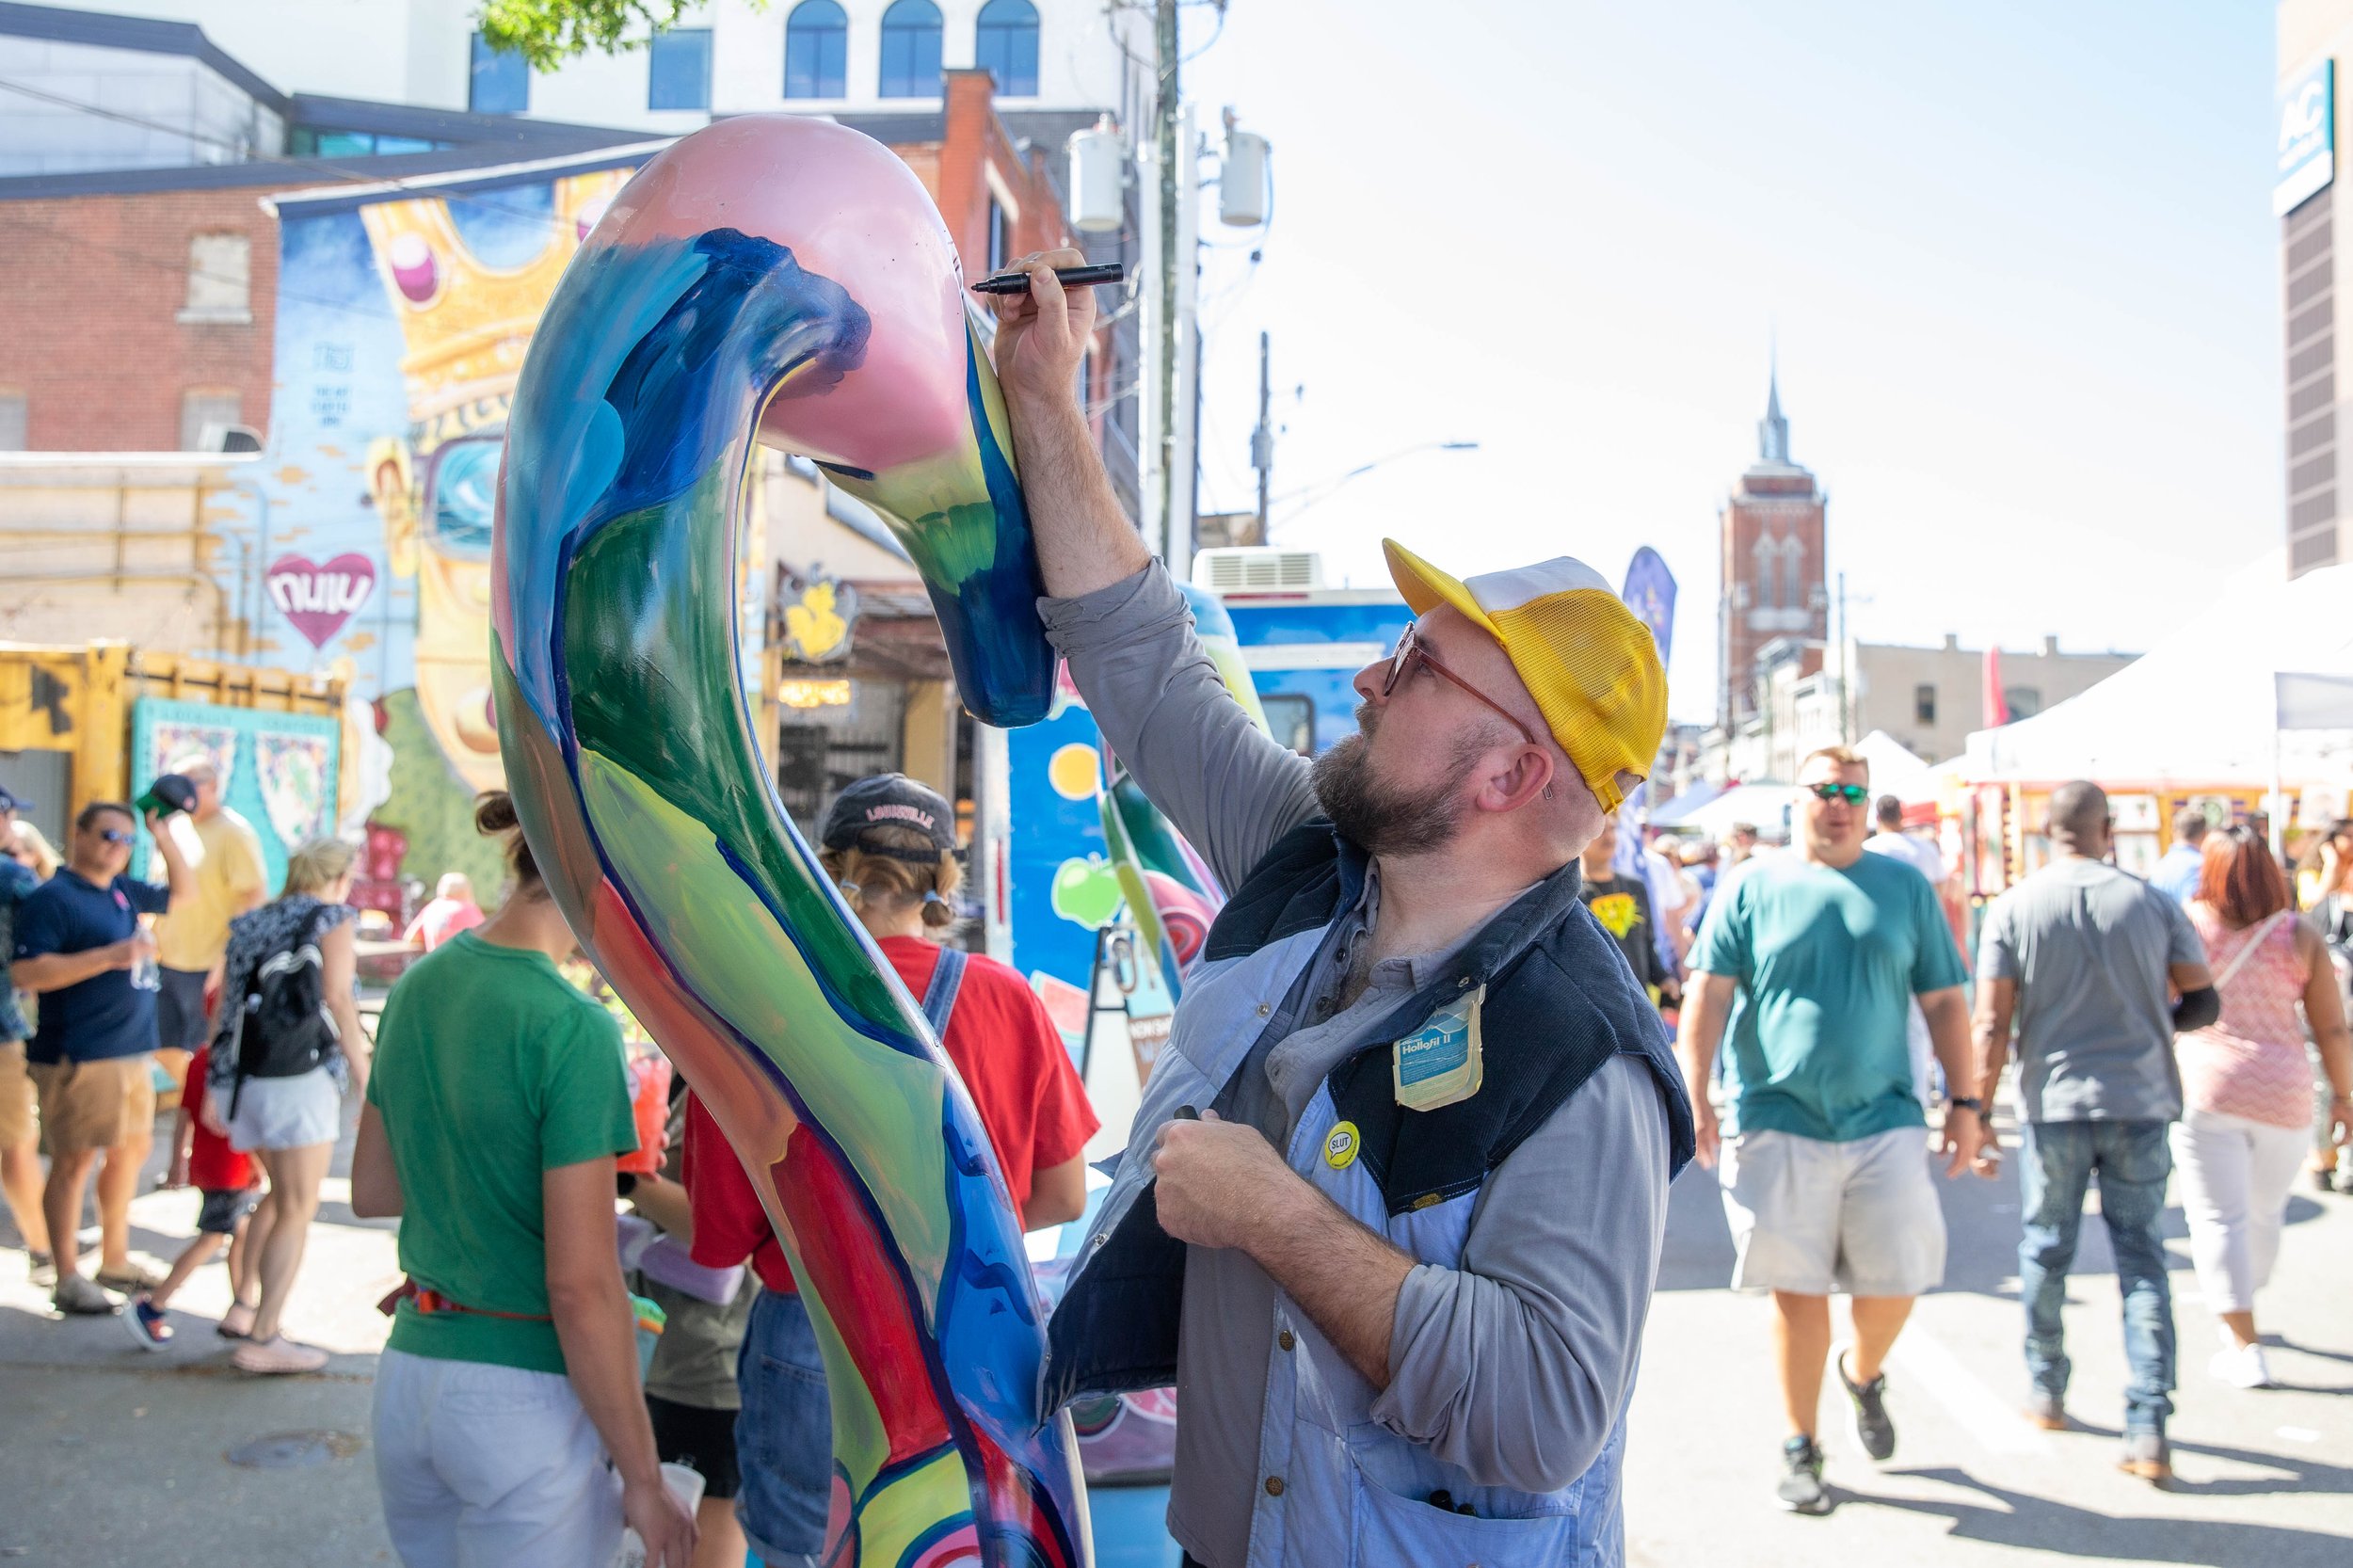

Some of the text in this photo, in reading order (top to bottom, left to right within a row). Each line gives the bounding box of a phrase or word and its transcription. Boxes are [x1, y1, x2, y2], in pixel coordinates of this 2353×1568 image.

[866, 805, 935, 829] LOUISVILLE
[1402, 1036, 1440, 1054] Hollofil
[1332, 1136, 1350, 1149] SLUT
